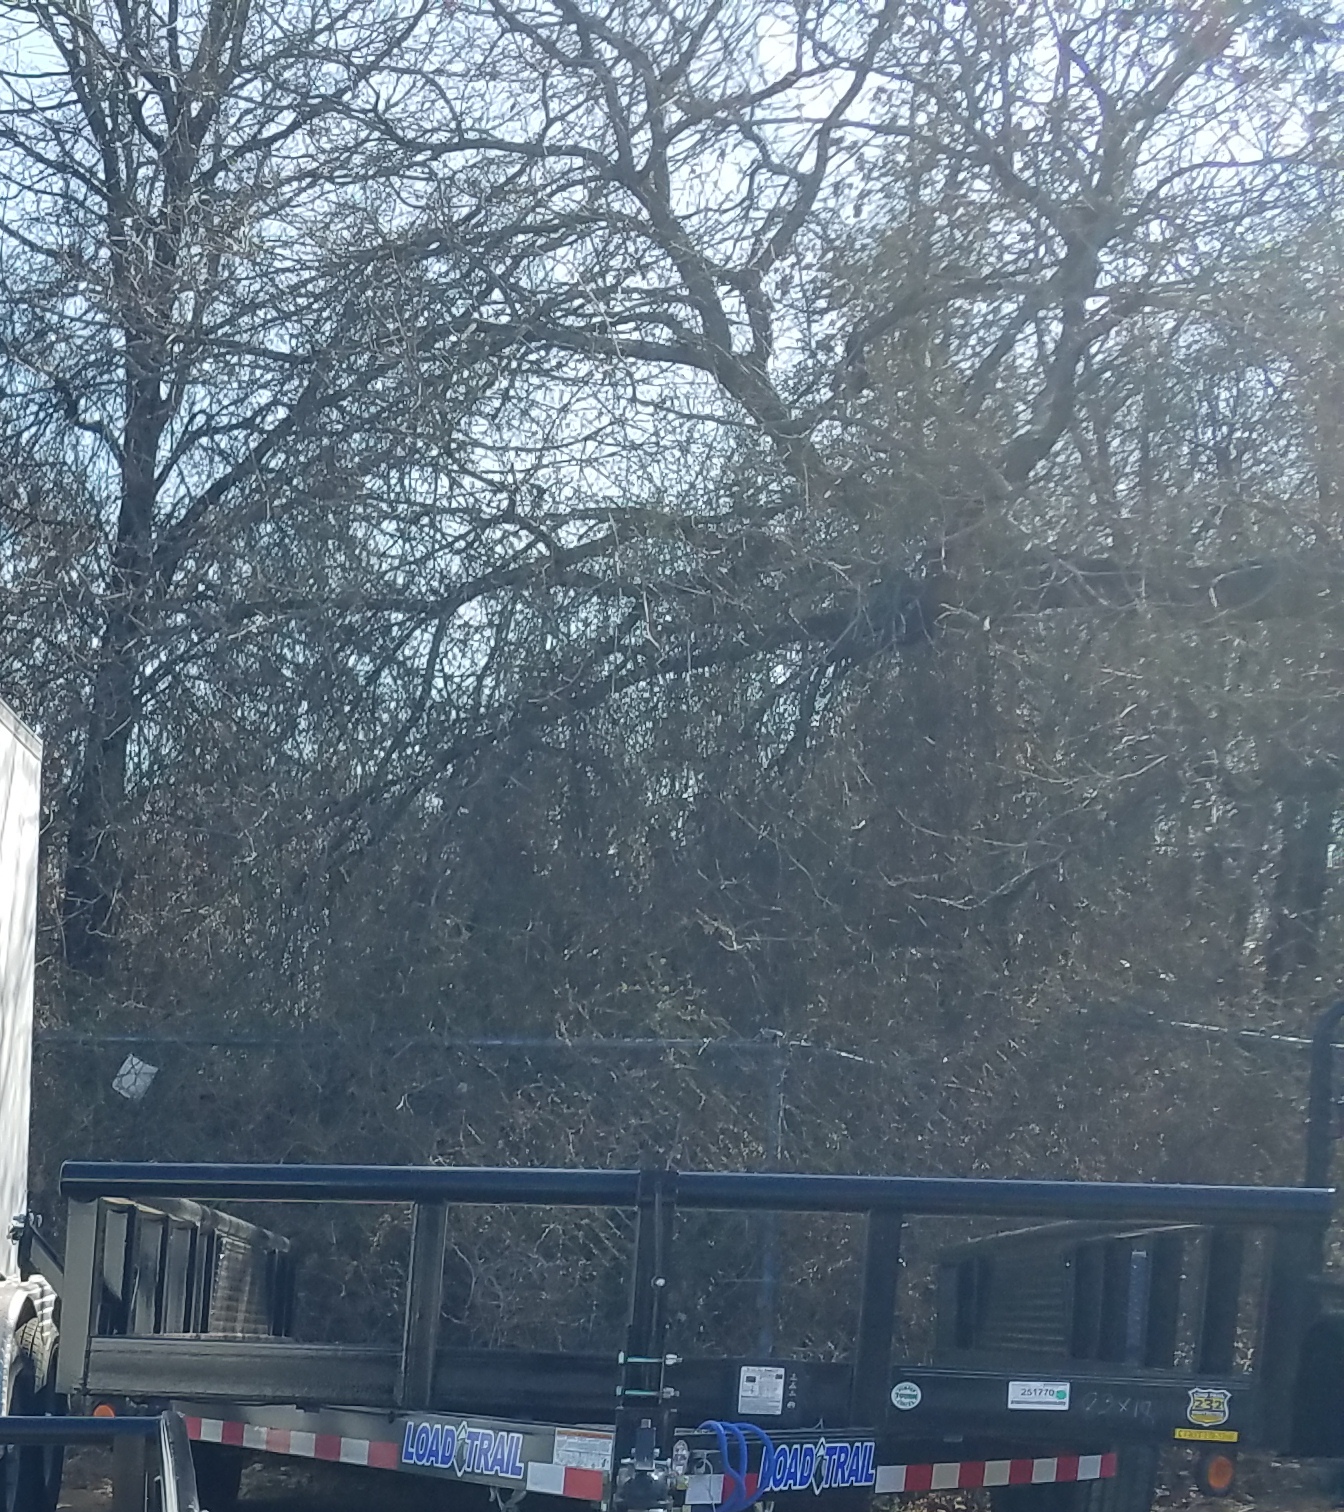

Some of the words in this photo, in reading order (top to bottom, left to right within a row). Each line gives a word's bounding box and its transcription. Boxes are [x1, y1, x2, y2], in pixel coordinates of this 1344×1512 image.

[402, 1420, 457, 1469] LOAD
[464, 1427, 525, 1480] TRAIL
[823, 1442, 876, 1488] TRAIL
